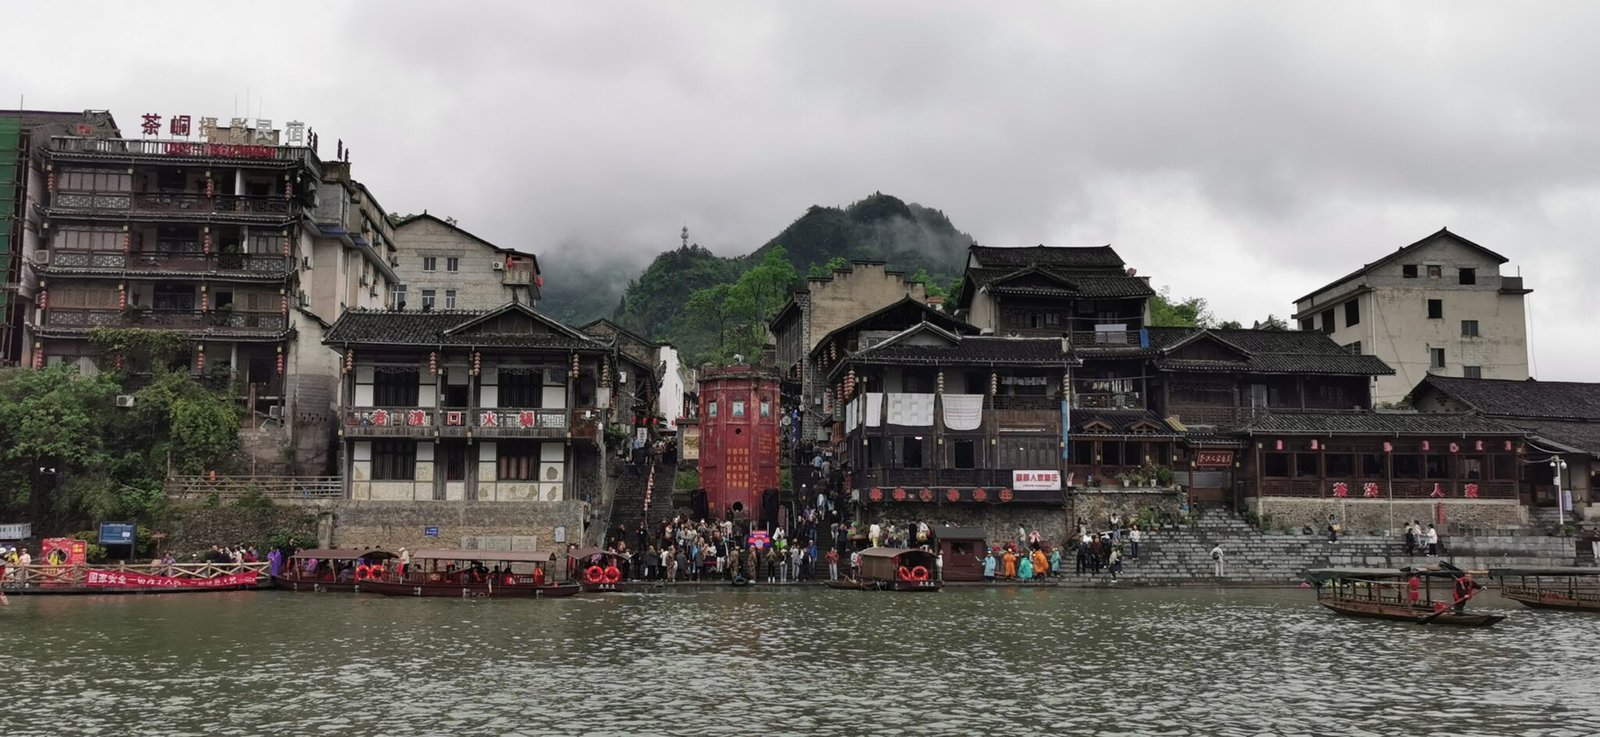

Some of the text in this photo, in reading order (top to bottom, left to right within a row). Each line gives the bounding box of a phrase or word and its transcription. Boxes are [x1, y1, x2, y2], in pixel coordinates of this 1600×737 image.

[141, 112, 305, 142] 茶峒摄影民宿
